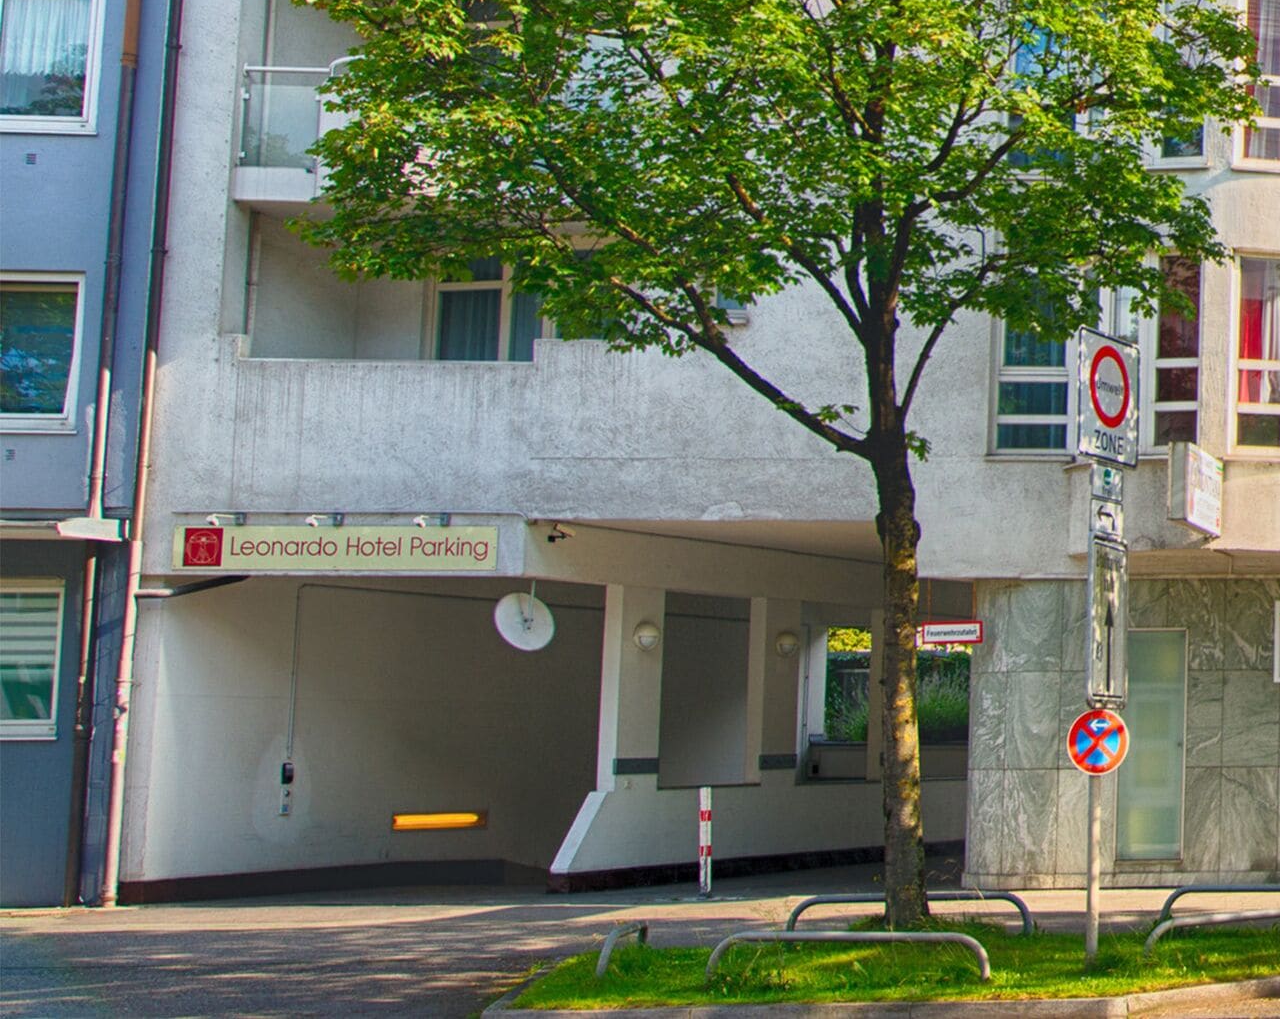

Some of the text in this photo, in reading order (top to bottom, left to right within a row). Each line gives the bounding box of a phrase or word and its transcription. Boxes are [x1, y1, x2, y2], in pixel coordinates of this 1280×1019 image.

[1094, 430, 1124, 456] ZONE
[230, 536, 489, 561] Leonardo Hotel Parking
